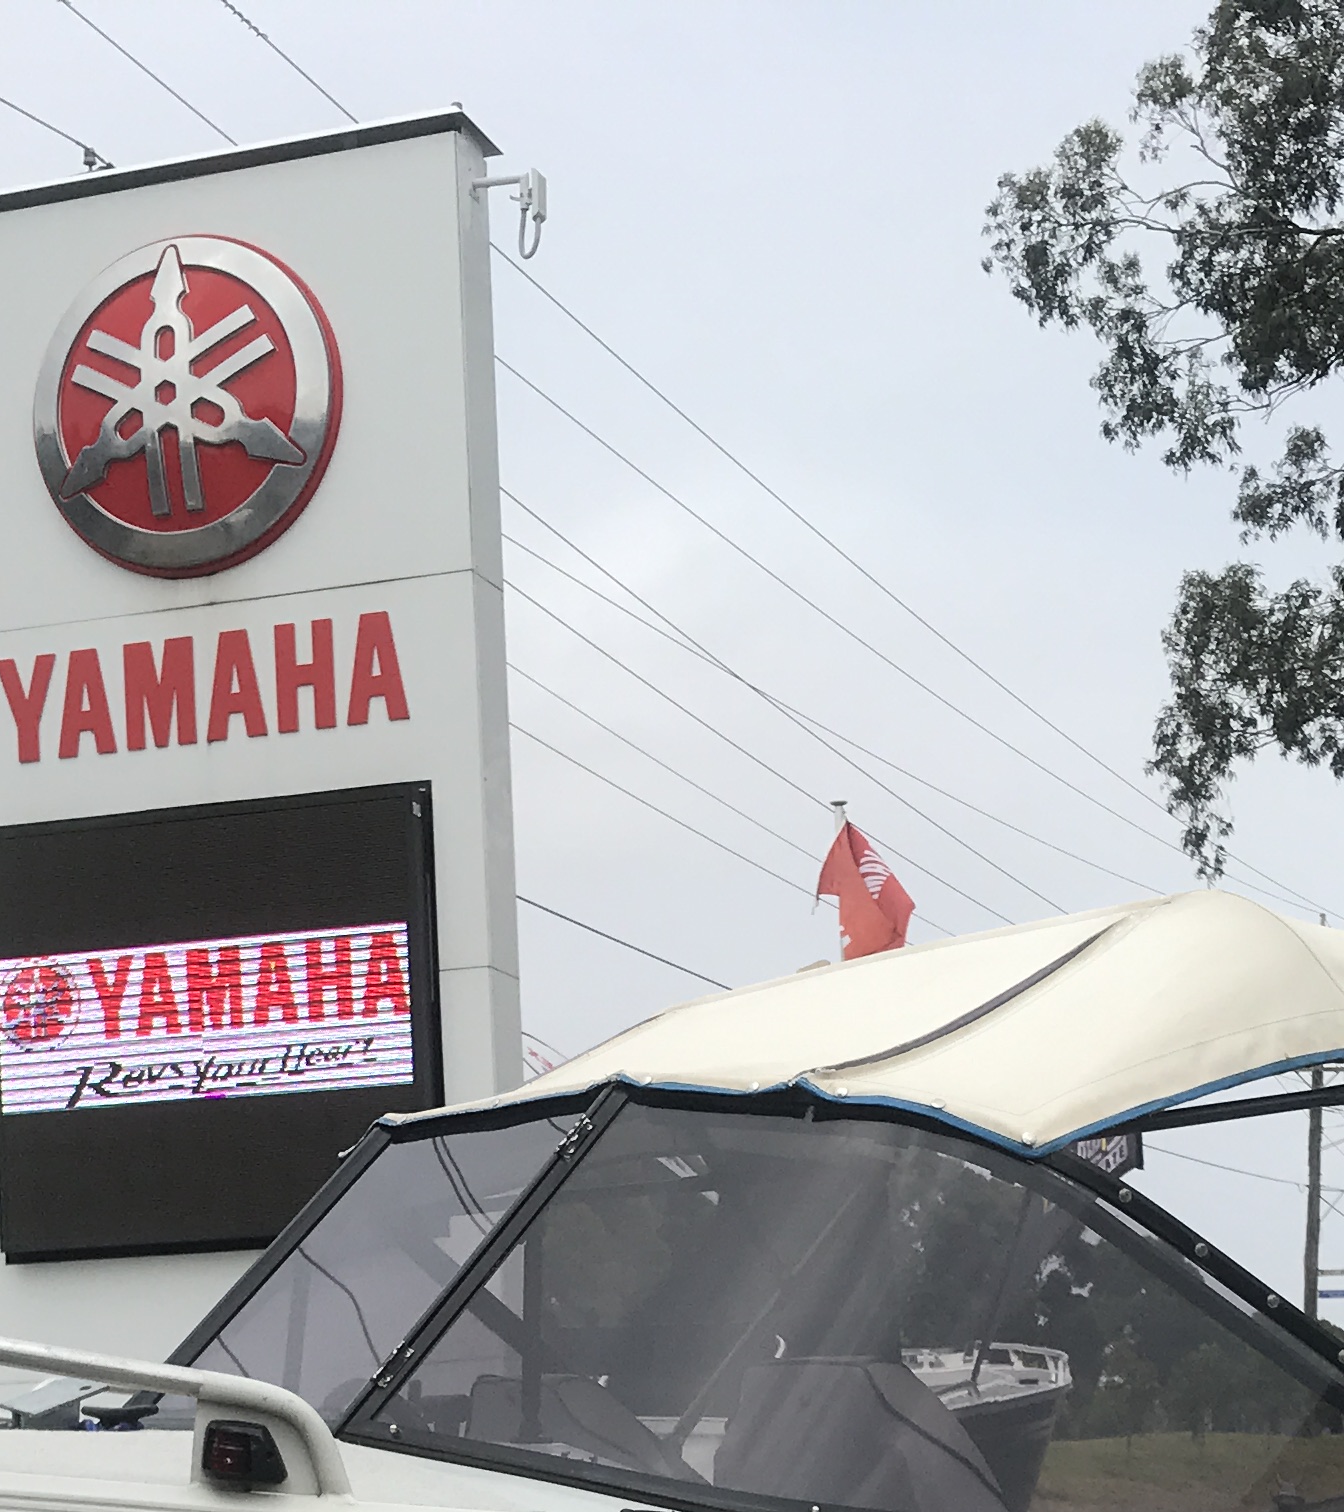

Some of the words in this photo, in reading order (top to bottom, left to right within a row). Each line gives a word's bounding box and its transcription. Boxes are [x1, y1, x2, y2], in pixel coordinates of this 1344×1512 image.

[87, 932, 412, 1040] YAMAHA
[63, 1061, 183, 1109] Revs
[192, 1055, 270, 1094] Your
[280, 1037, 374, 1076] Heart
